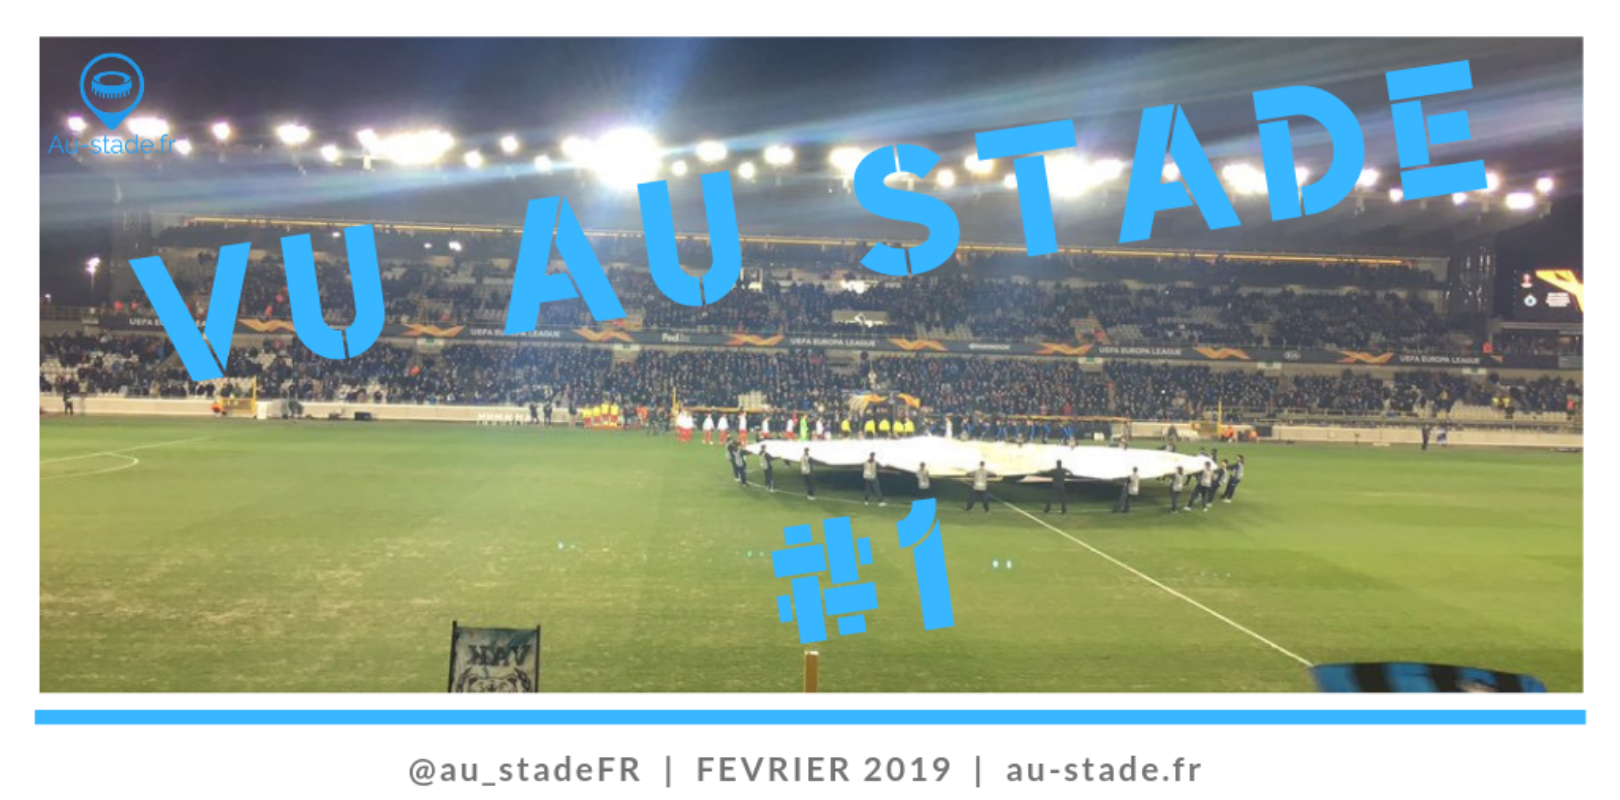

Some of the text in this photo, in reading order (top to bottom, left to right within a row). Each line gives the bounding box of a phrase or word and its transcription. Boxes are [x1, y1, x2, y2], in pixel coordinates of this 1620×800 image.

[1099, 346, 1182, 355] UEFA EUROPA LEAGUE
